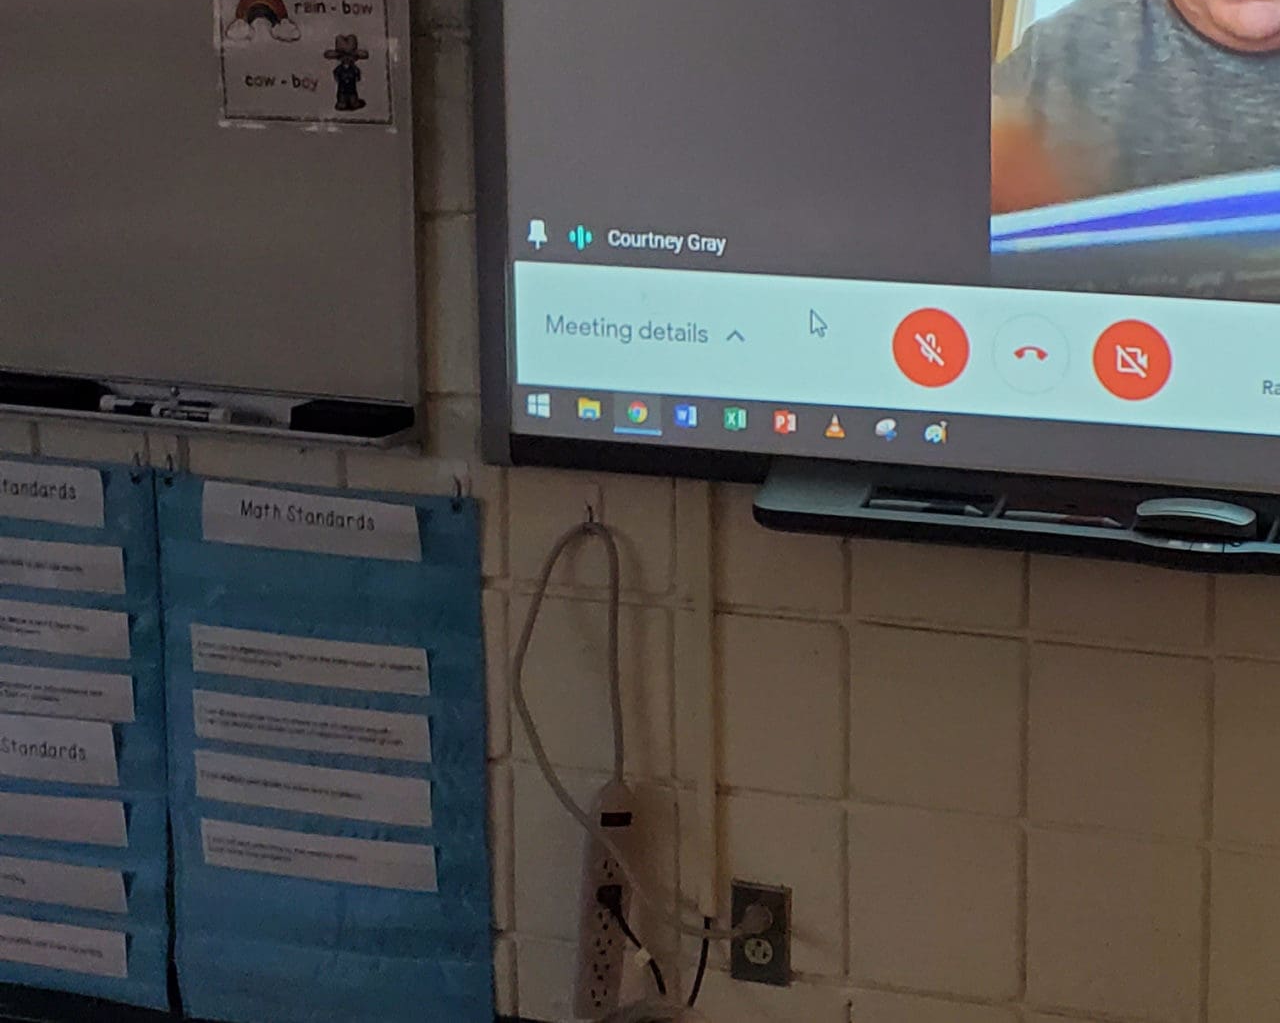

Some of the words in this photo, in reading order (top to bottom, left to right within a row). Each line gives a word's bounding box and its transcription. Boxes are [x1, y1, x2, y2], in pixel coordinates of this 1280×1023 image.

[294, 0, 326, 14] rain
[343, 0, 373, 15] bow
[245, 75, 275, 87] cow
[291, 74, 318, 92] boy
[607, 229, 683, 254] Courtney
[687, 233, 727, 257] Gray
[545, 314, 632, 342] Meeting
[639, 320, 709, 344] details
[0, 480, 77, 501] tandards
[240, 500, 282, 523] Math
[286, 504, 376, 532] Standards
[1, 736, 87, 762] Standards
